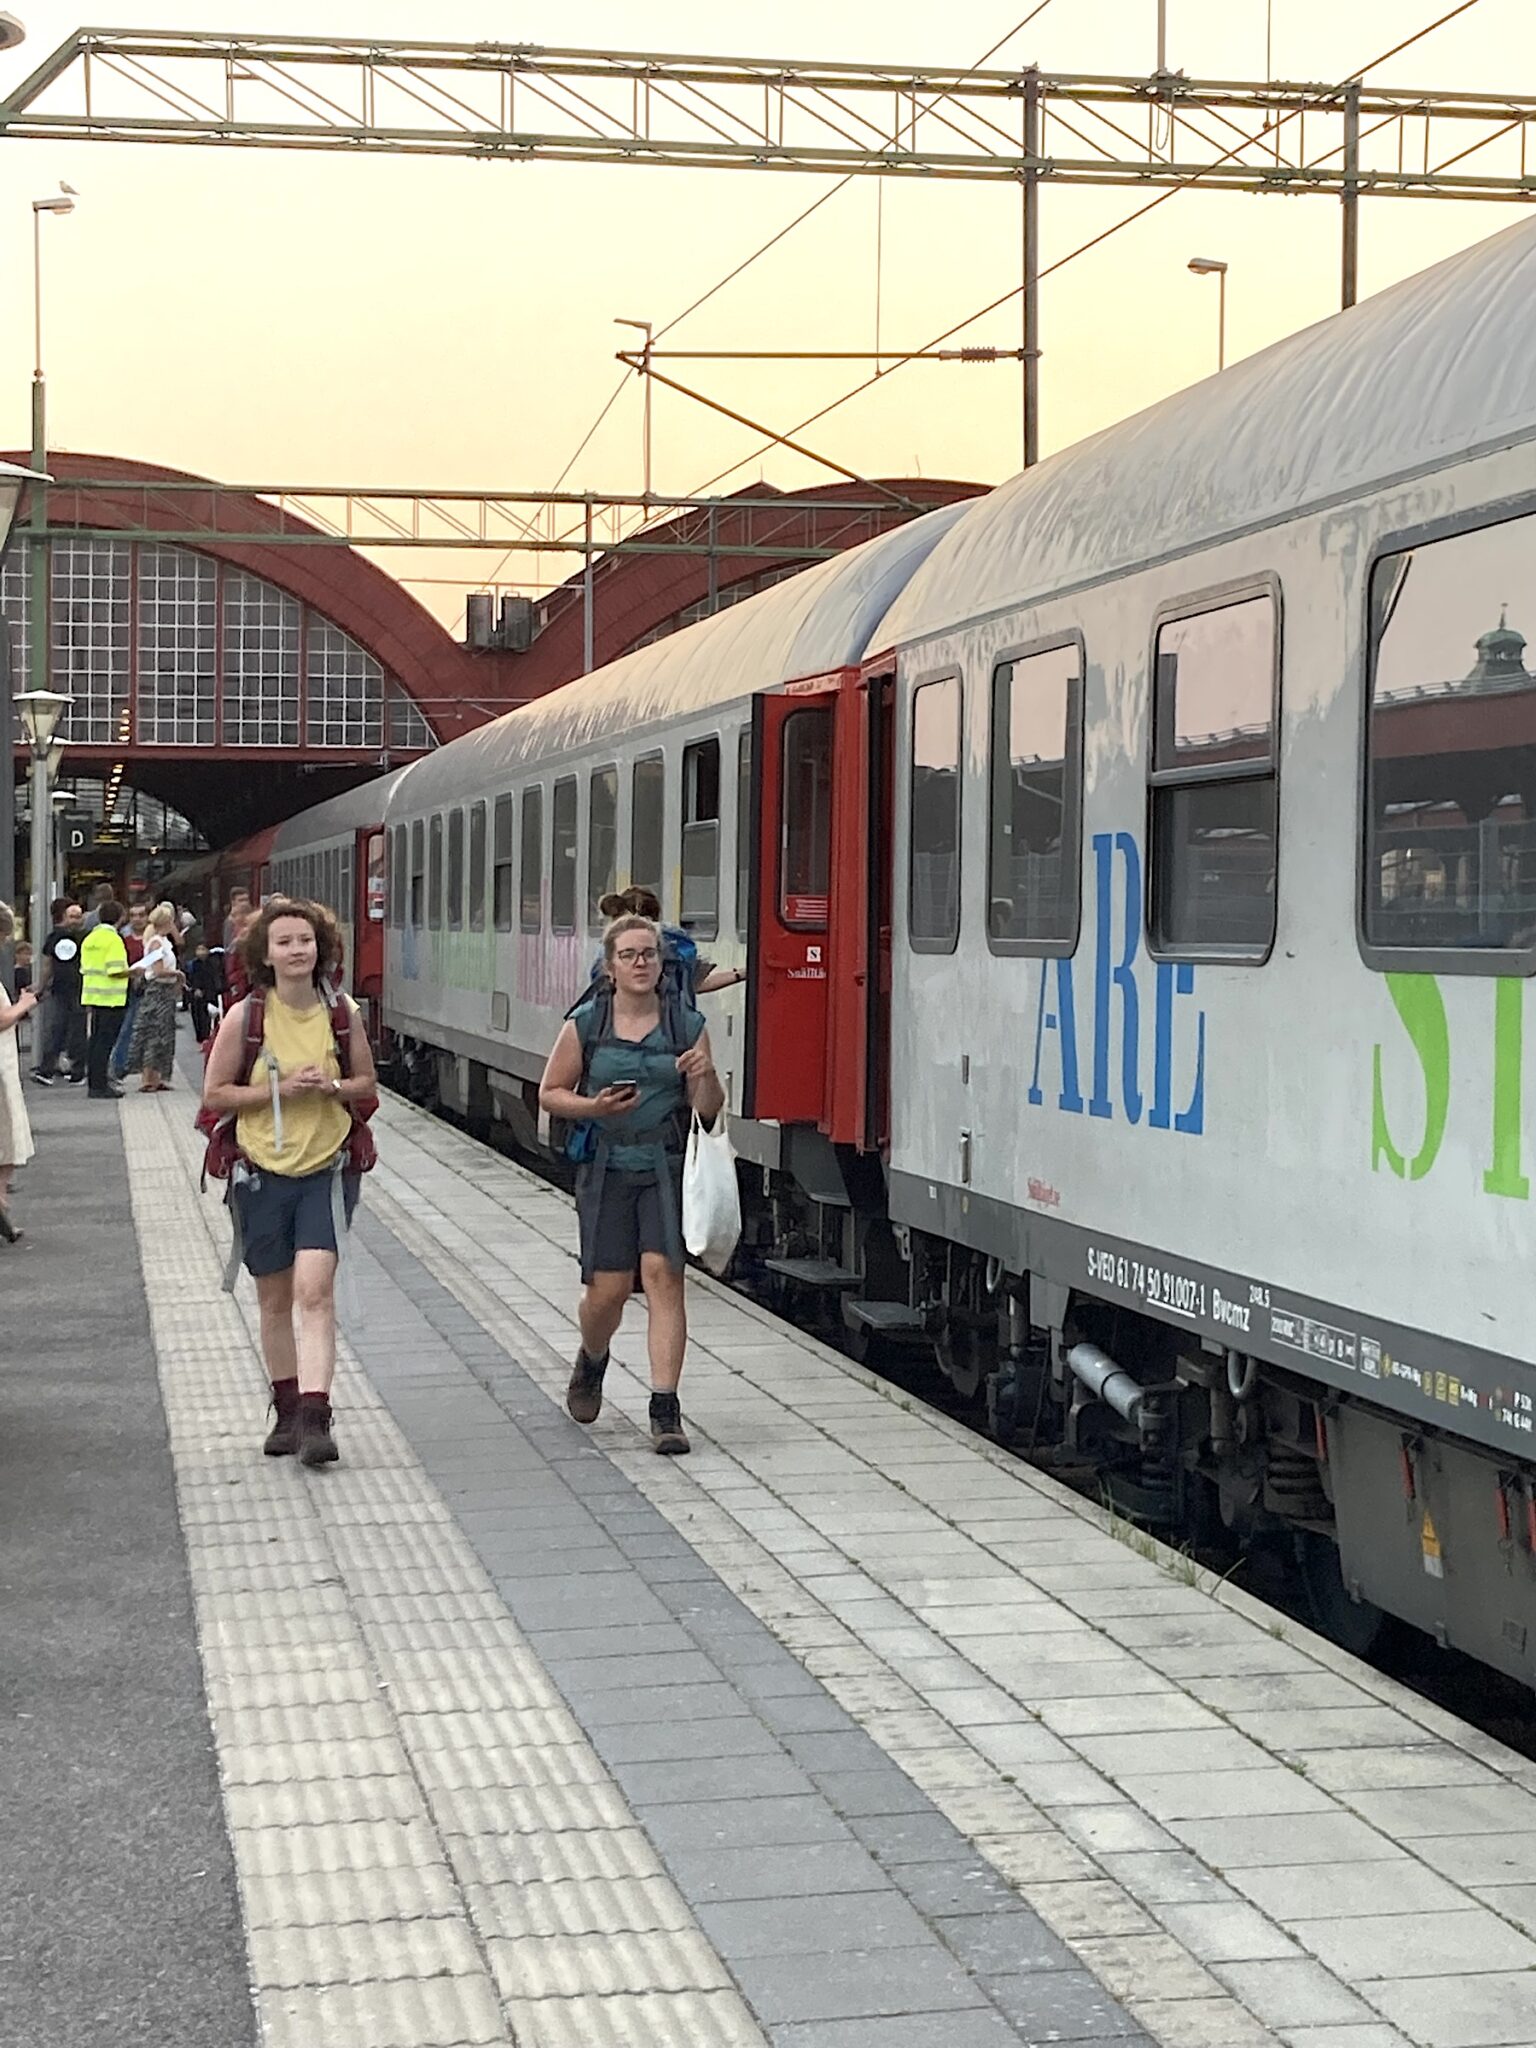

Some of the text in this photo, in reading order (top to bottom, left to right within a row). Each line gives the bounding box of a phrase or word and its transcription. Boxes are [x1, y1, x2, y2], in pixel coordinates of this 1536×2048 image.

[71, 830, 84, 847] D
[1116, 1256, 1129, 1289] 61
[1132, 1261, 1145, 1295] 74
[1147, 1267, 1161, 1299] 50
[1163, 1271, 1206, 1316] 91007-1
[1212, 1288, 1250, 1332] Bvcmz
